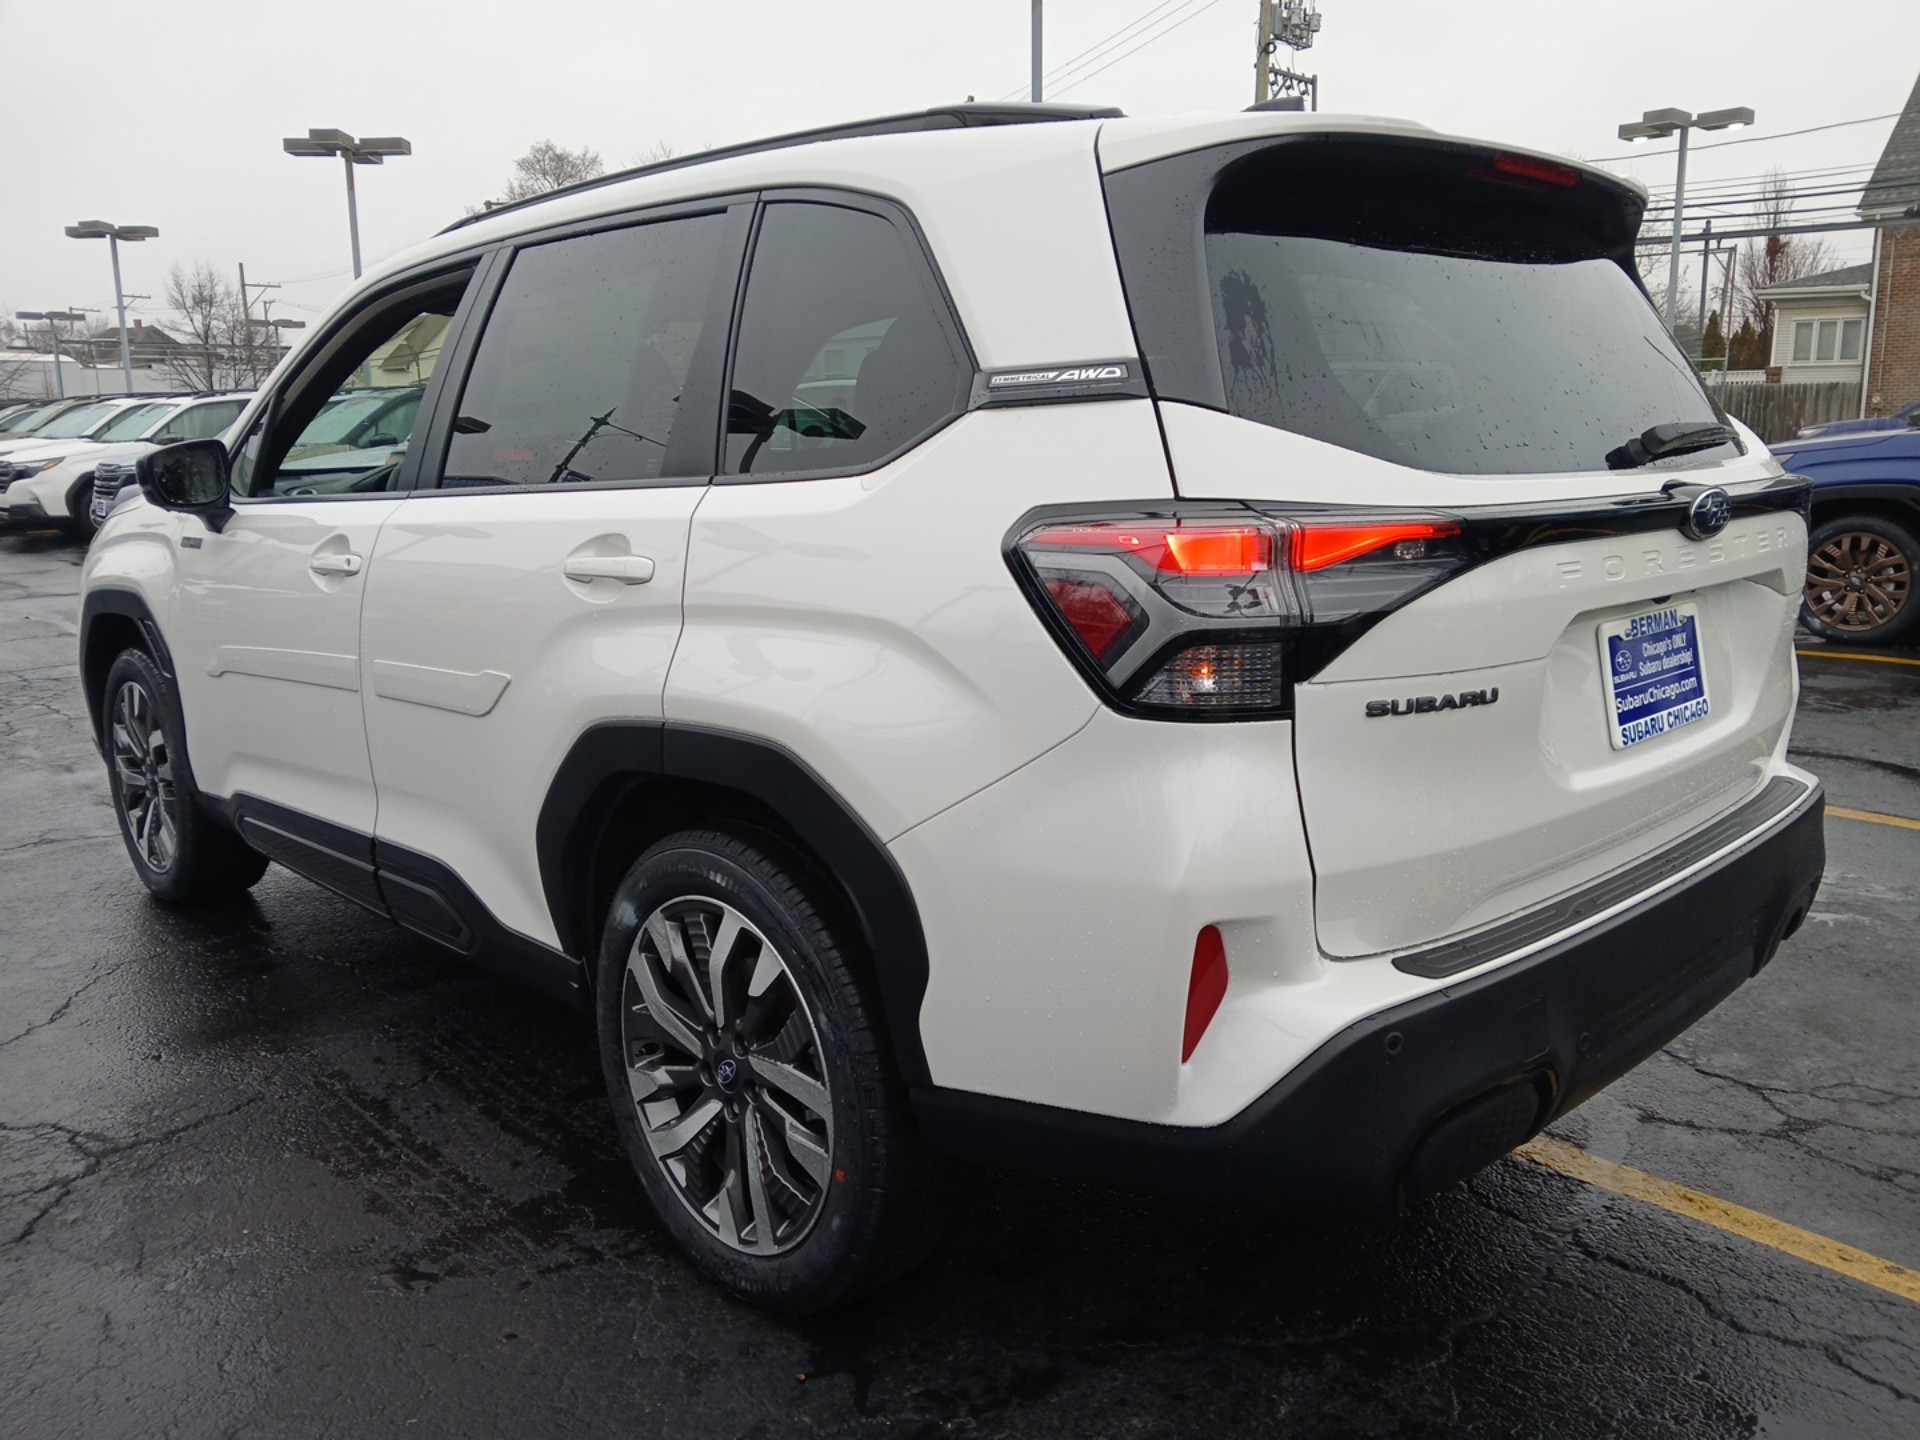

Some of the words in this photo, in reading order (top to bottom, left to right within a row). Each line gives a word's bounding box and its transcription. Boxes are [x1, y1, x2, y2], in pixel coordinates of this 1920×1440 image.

[991, 373, 1056, 384] SYMMETRICAL
[1056, 367, 1121, 381] AWD
[1556, 528, 1788, 587] FORESTER
[1631, 609, 1678, 637] BERMAN
[1642, 638, 1672, 656] Chicago's
[1672, 633, 1687, 648] ONLY
[1639, 661, 1661, 676] Subaru
[1662, 649, 1693, 670] dealership!
[1614, 672, 1637, 683] SUBARU
[1365, 687, 1499, 717] SUBARU
[1616, 677, 1697, 712] SubaruChicago.com
[1621, 715, 1665, 745] SUBARU
[1667, 698, 1709, 728] CHICAGO
